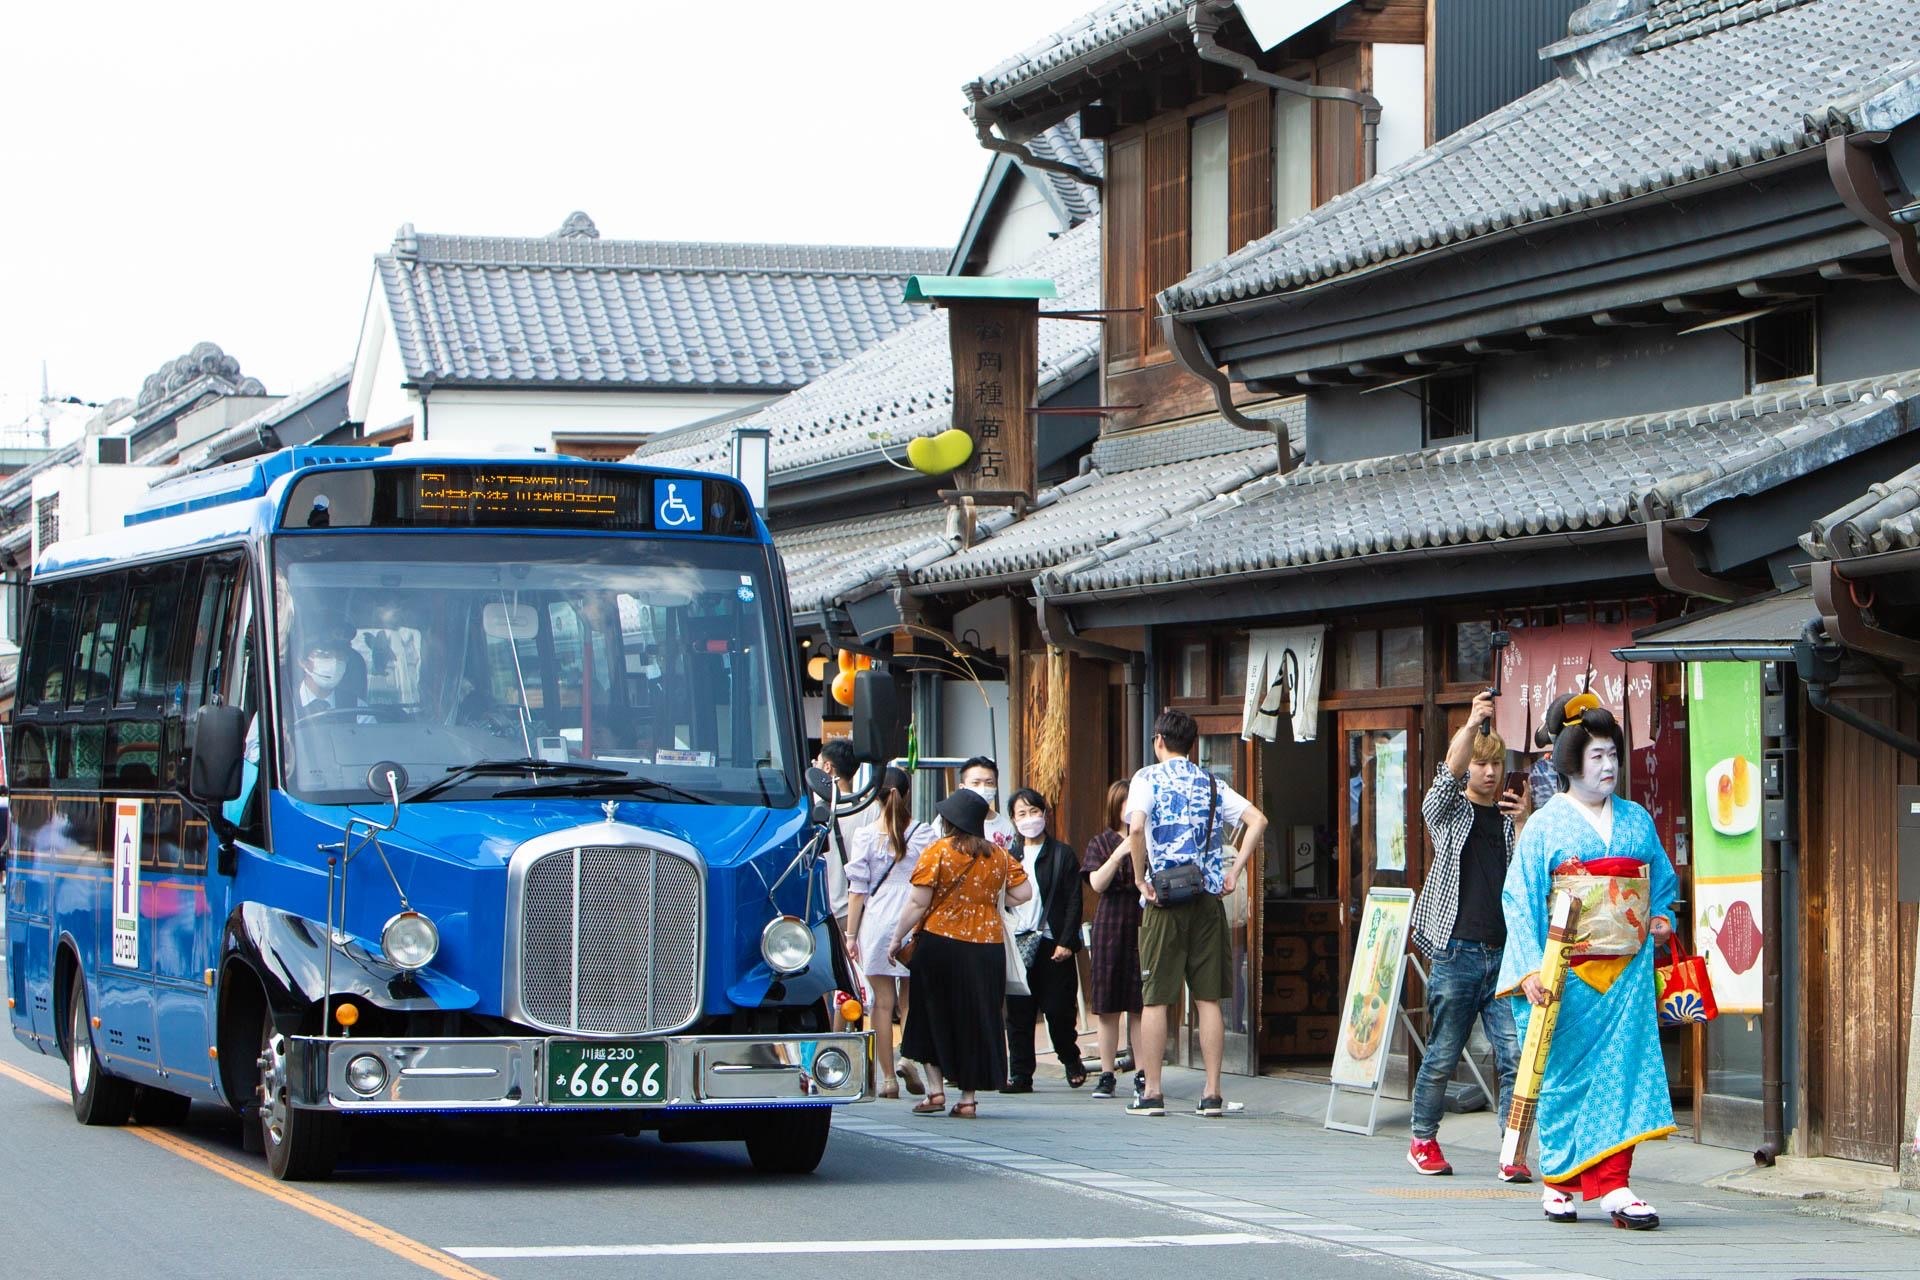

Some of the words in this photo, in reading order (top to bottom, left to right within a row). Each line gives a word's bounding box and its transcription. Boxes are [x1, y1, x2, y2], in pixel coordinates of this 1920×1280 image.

[973, 319, 1005, 479] 松岡種苗店
[570, 1062, 660, 1097] 66-66
